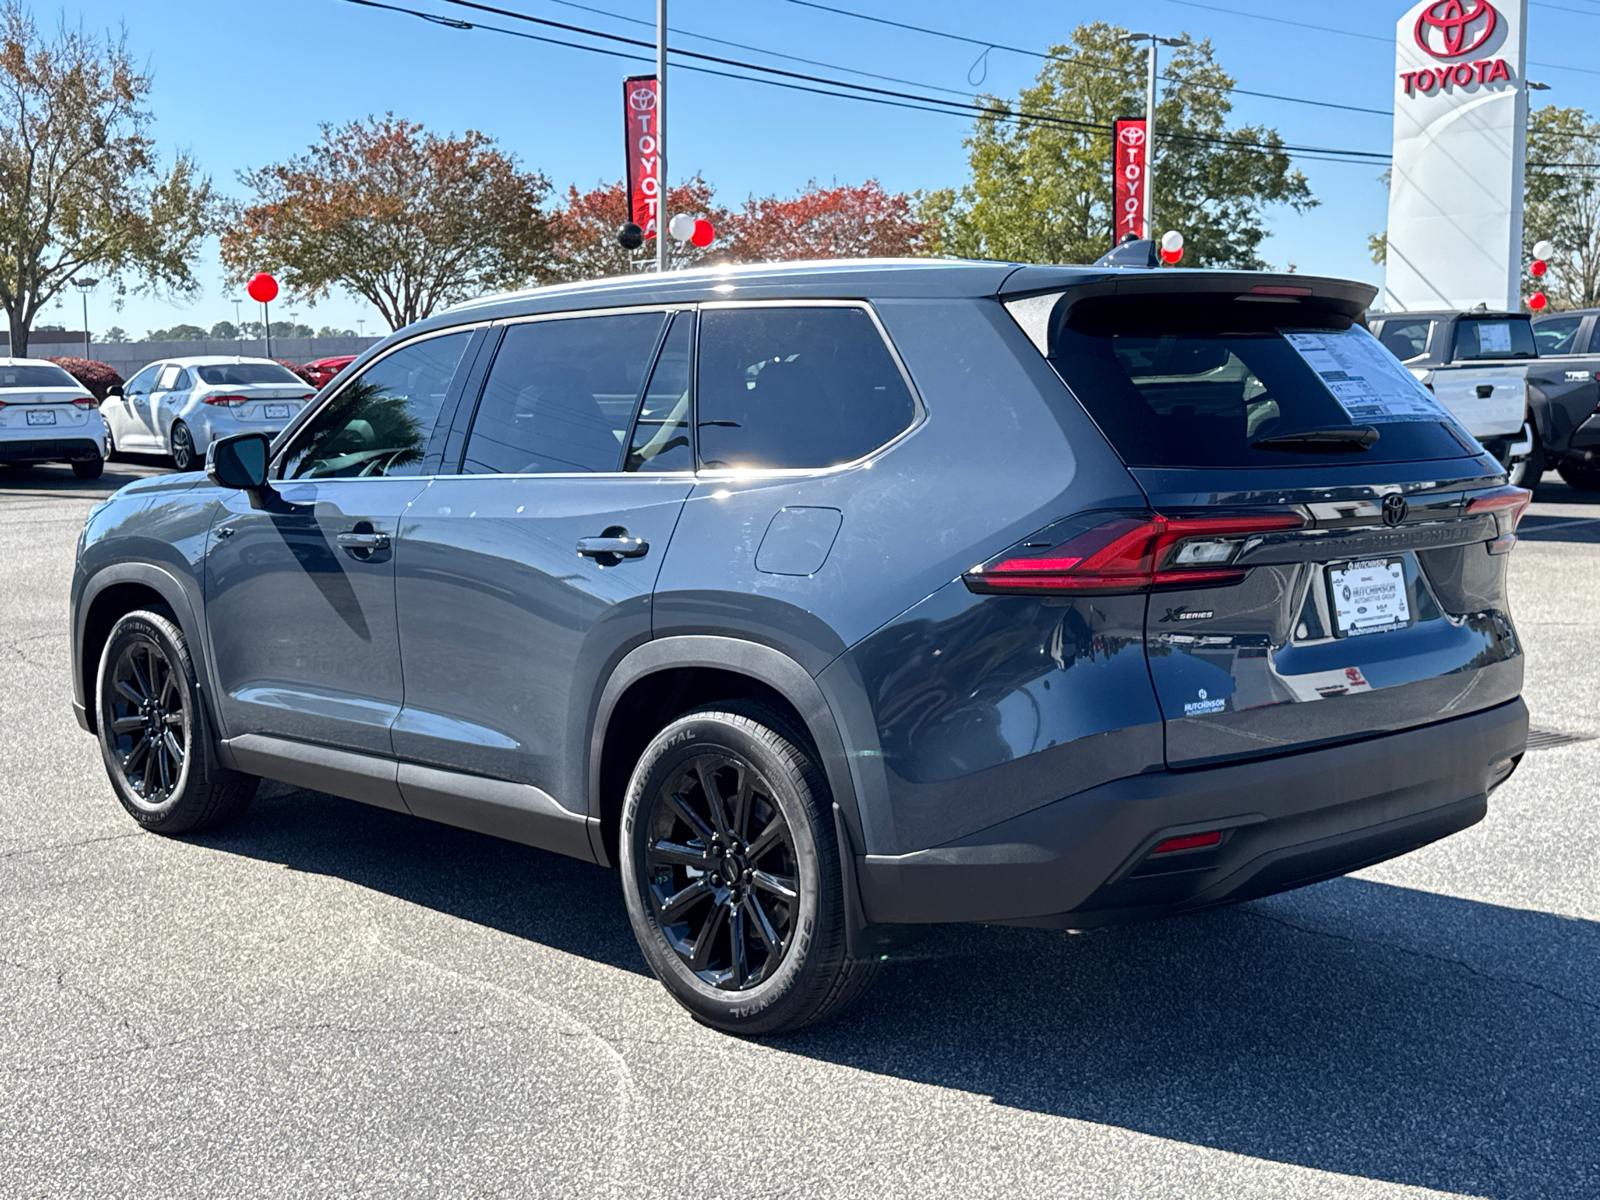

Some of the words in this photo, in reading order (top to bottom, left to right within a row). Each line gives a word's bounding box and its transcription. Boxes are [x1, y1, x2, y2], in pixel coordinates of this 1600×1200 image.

[1399, 59, 1510, 94] TOYOTA
[637, 115, 657, 235] TOYOTA
[1125, 148, 1140, 233] TOYOT
[1371, 527, 1470, 548] HIGHLANDER
[1354, 559, 1388, 570] HUTCHINSON
[1353, 584, 1396, 598] HUTCHINSON
[1180, 611, 1213, 620] SERIES
[1184, 699, 1226, 712] HUTCHINSON
